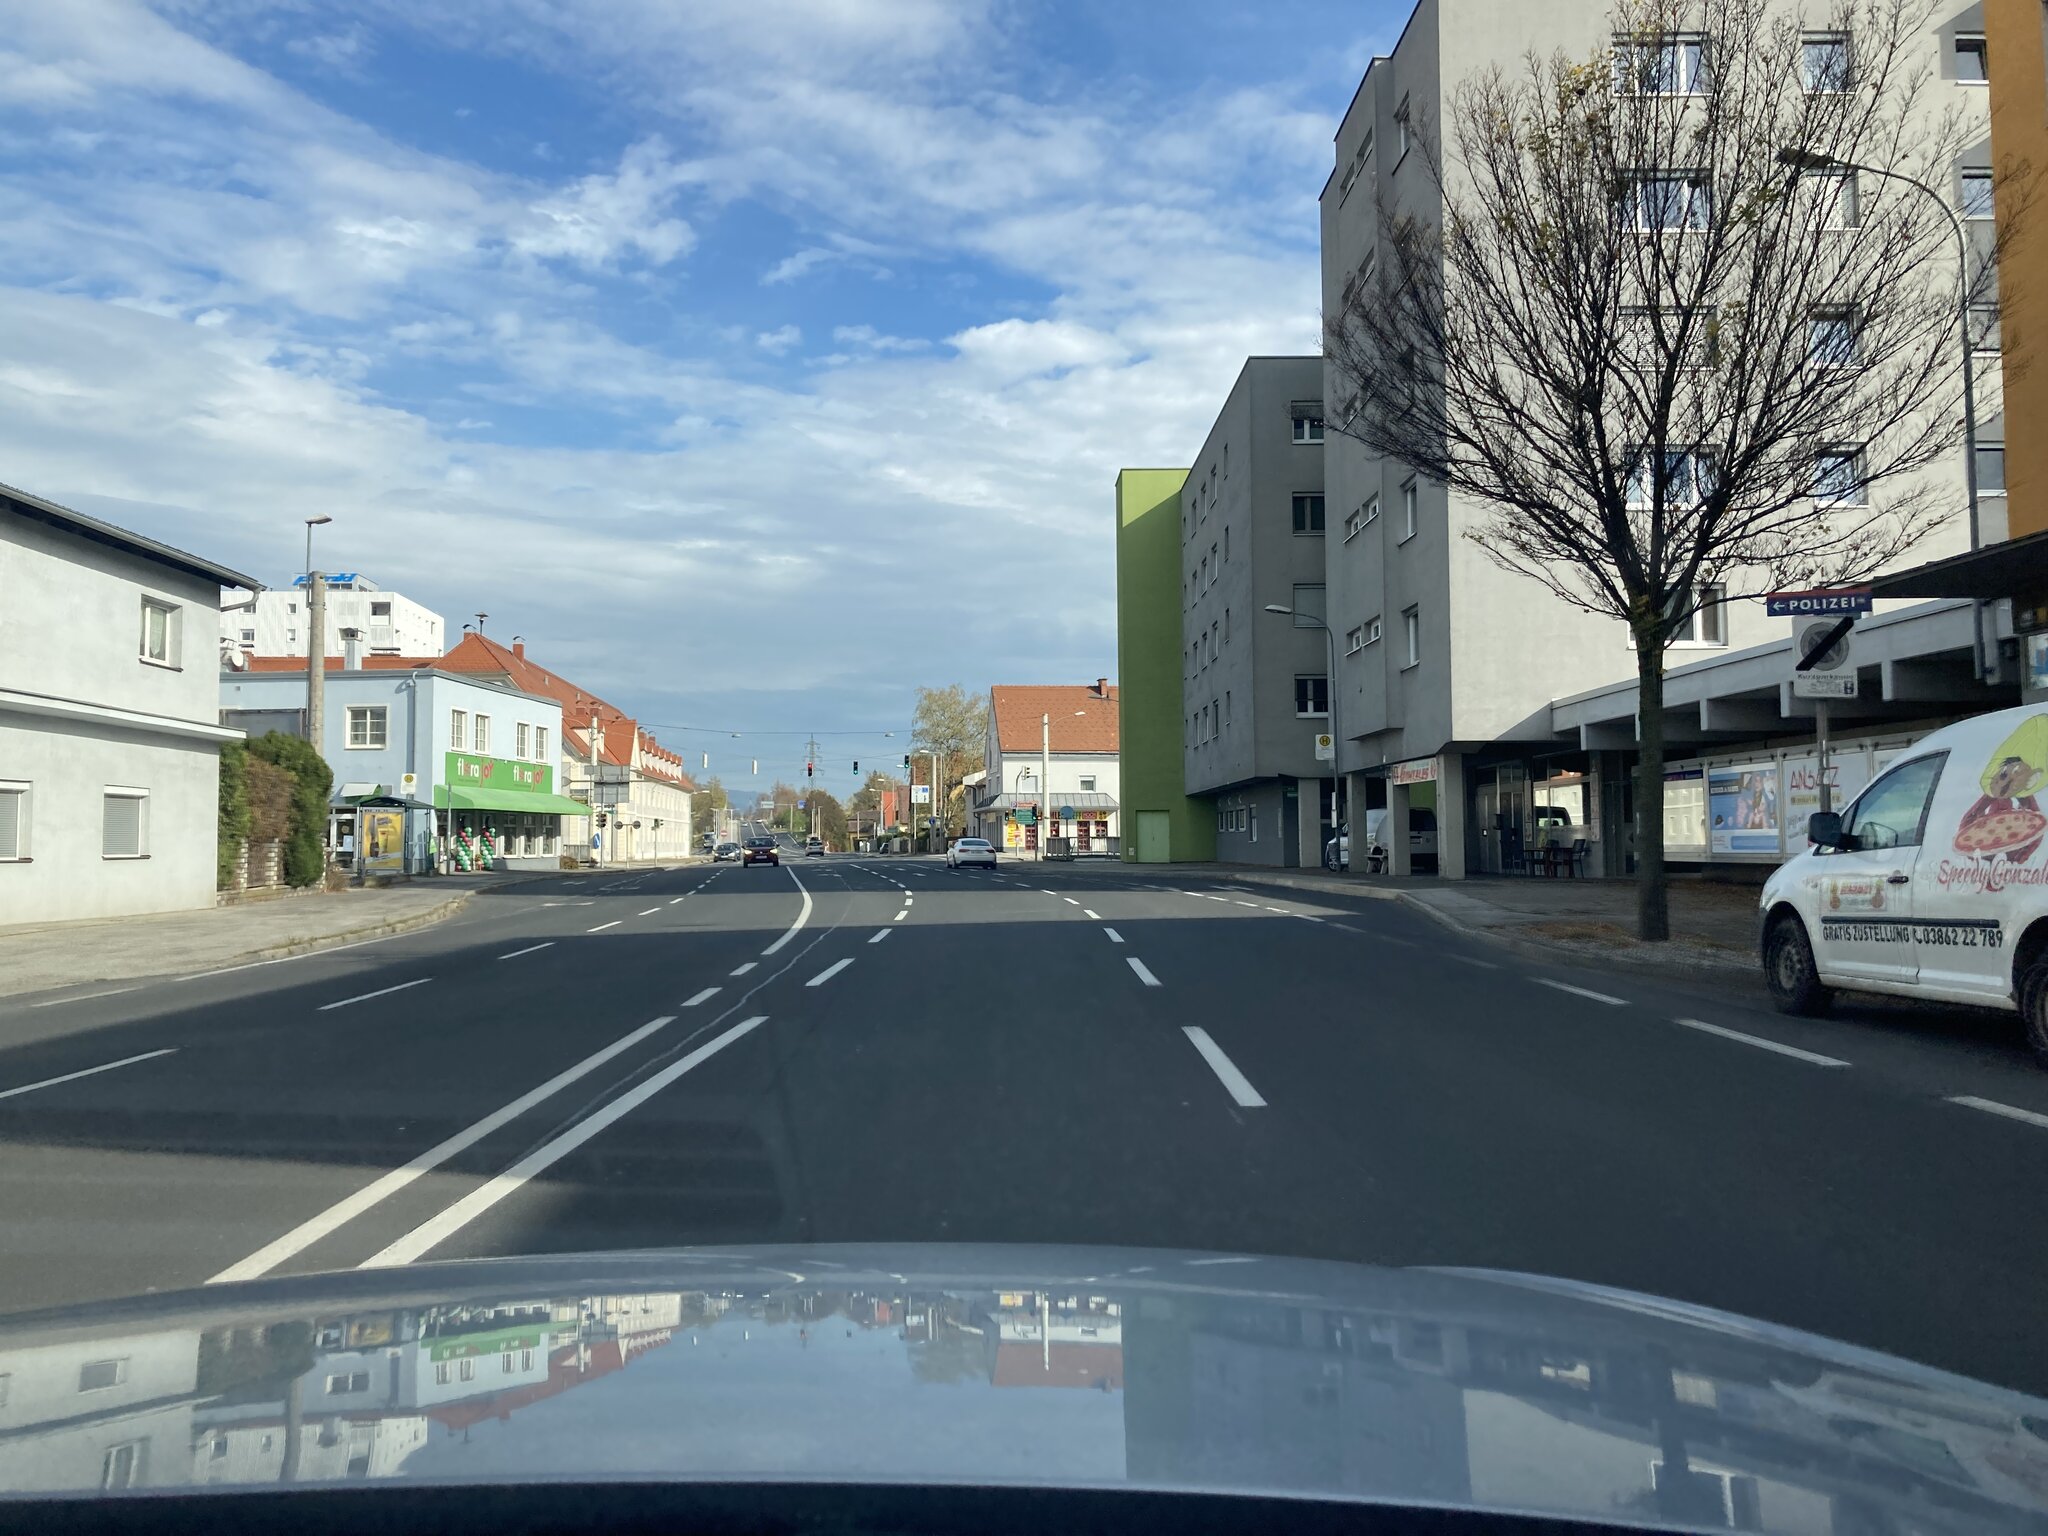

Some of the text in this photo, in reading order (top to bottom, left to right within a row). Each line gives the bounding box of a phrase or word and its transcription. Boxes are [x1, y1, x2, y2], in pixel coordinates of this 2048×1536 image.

[1789, 597, 1855, 611] POLIZEI
[1938, 857, 1988, 894] Speedy
[1823, 925, 2003, 948] GRATIS ZUSTELLUNG 03862 22 789
